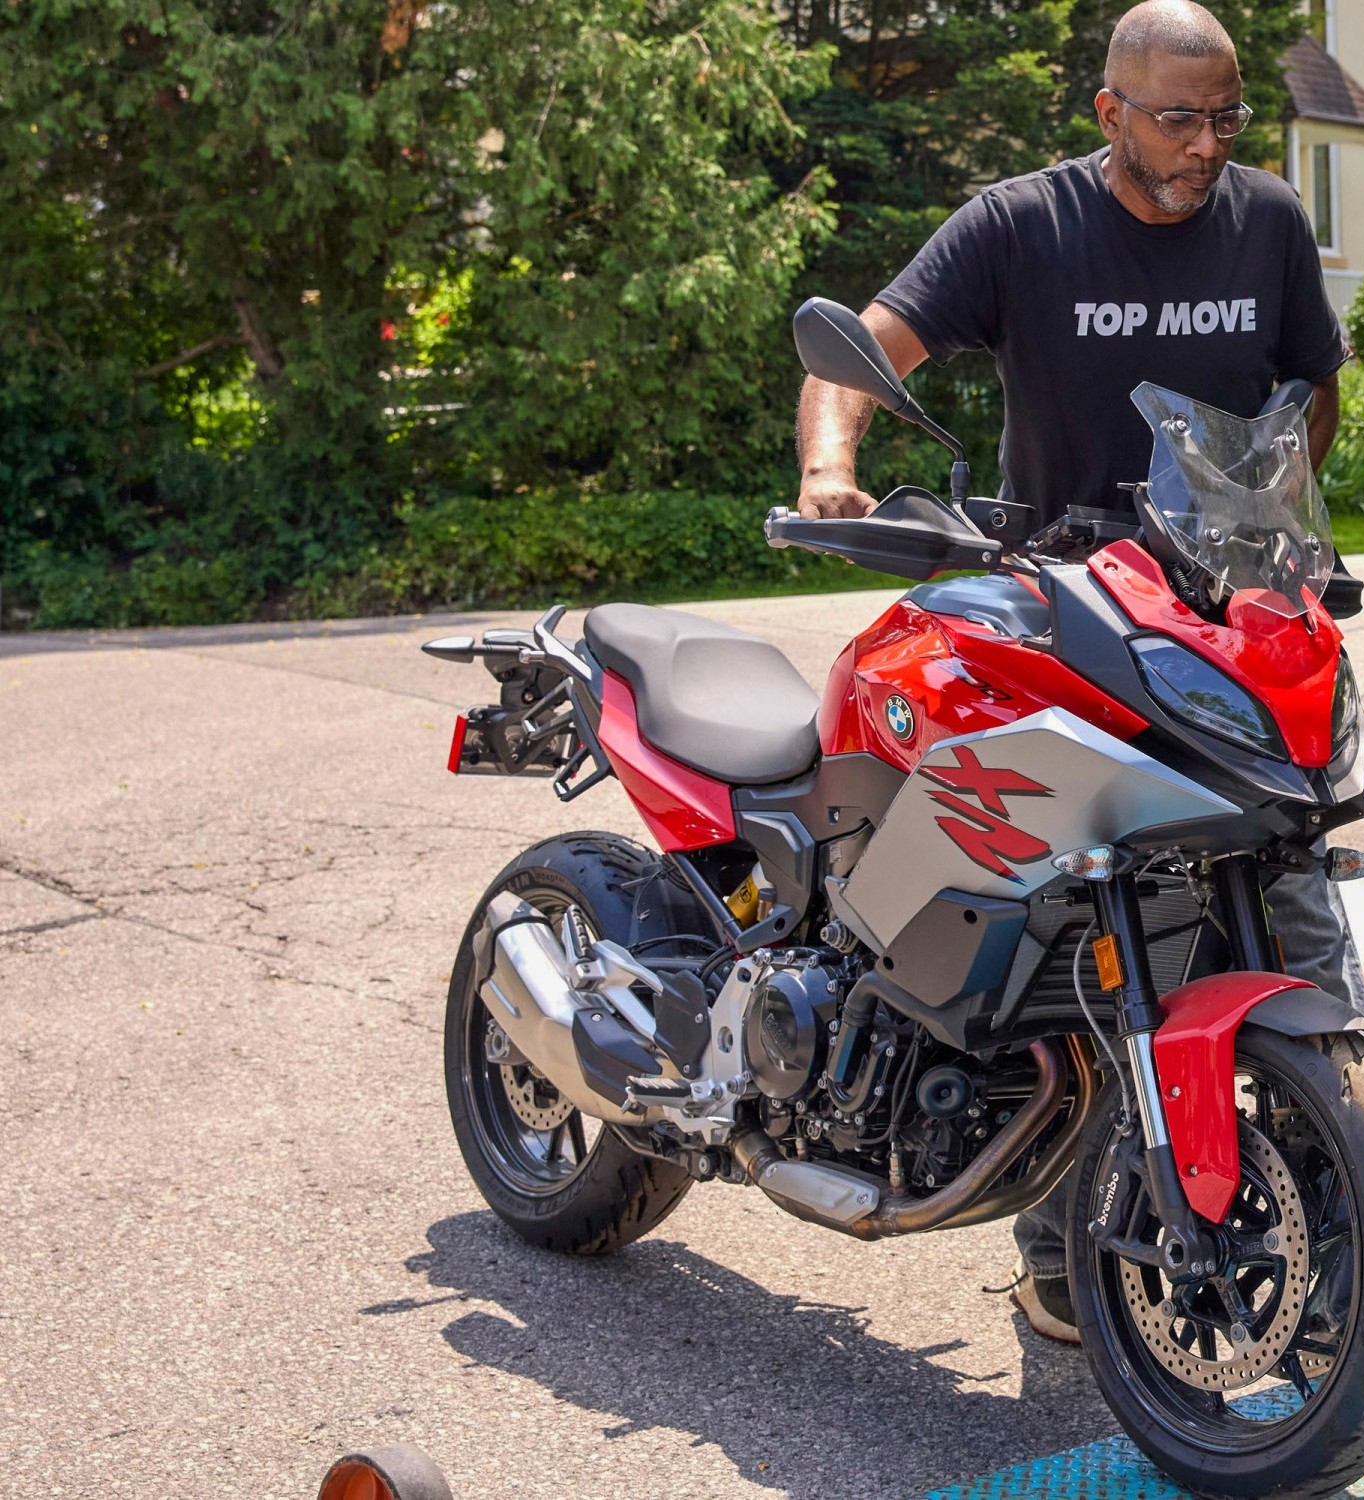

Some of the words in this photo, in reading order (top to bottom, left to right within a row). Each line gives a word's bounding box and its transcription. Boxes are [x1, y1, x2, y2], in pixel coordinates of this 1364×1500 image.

[1074, 302, 1148, 337] TOP
[1156, 298, 1256, 336] MOVE
[887, 698, 912, 718] BMW
[1097, 1172, 1120, 1227] brembo
